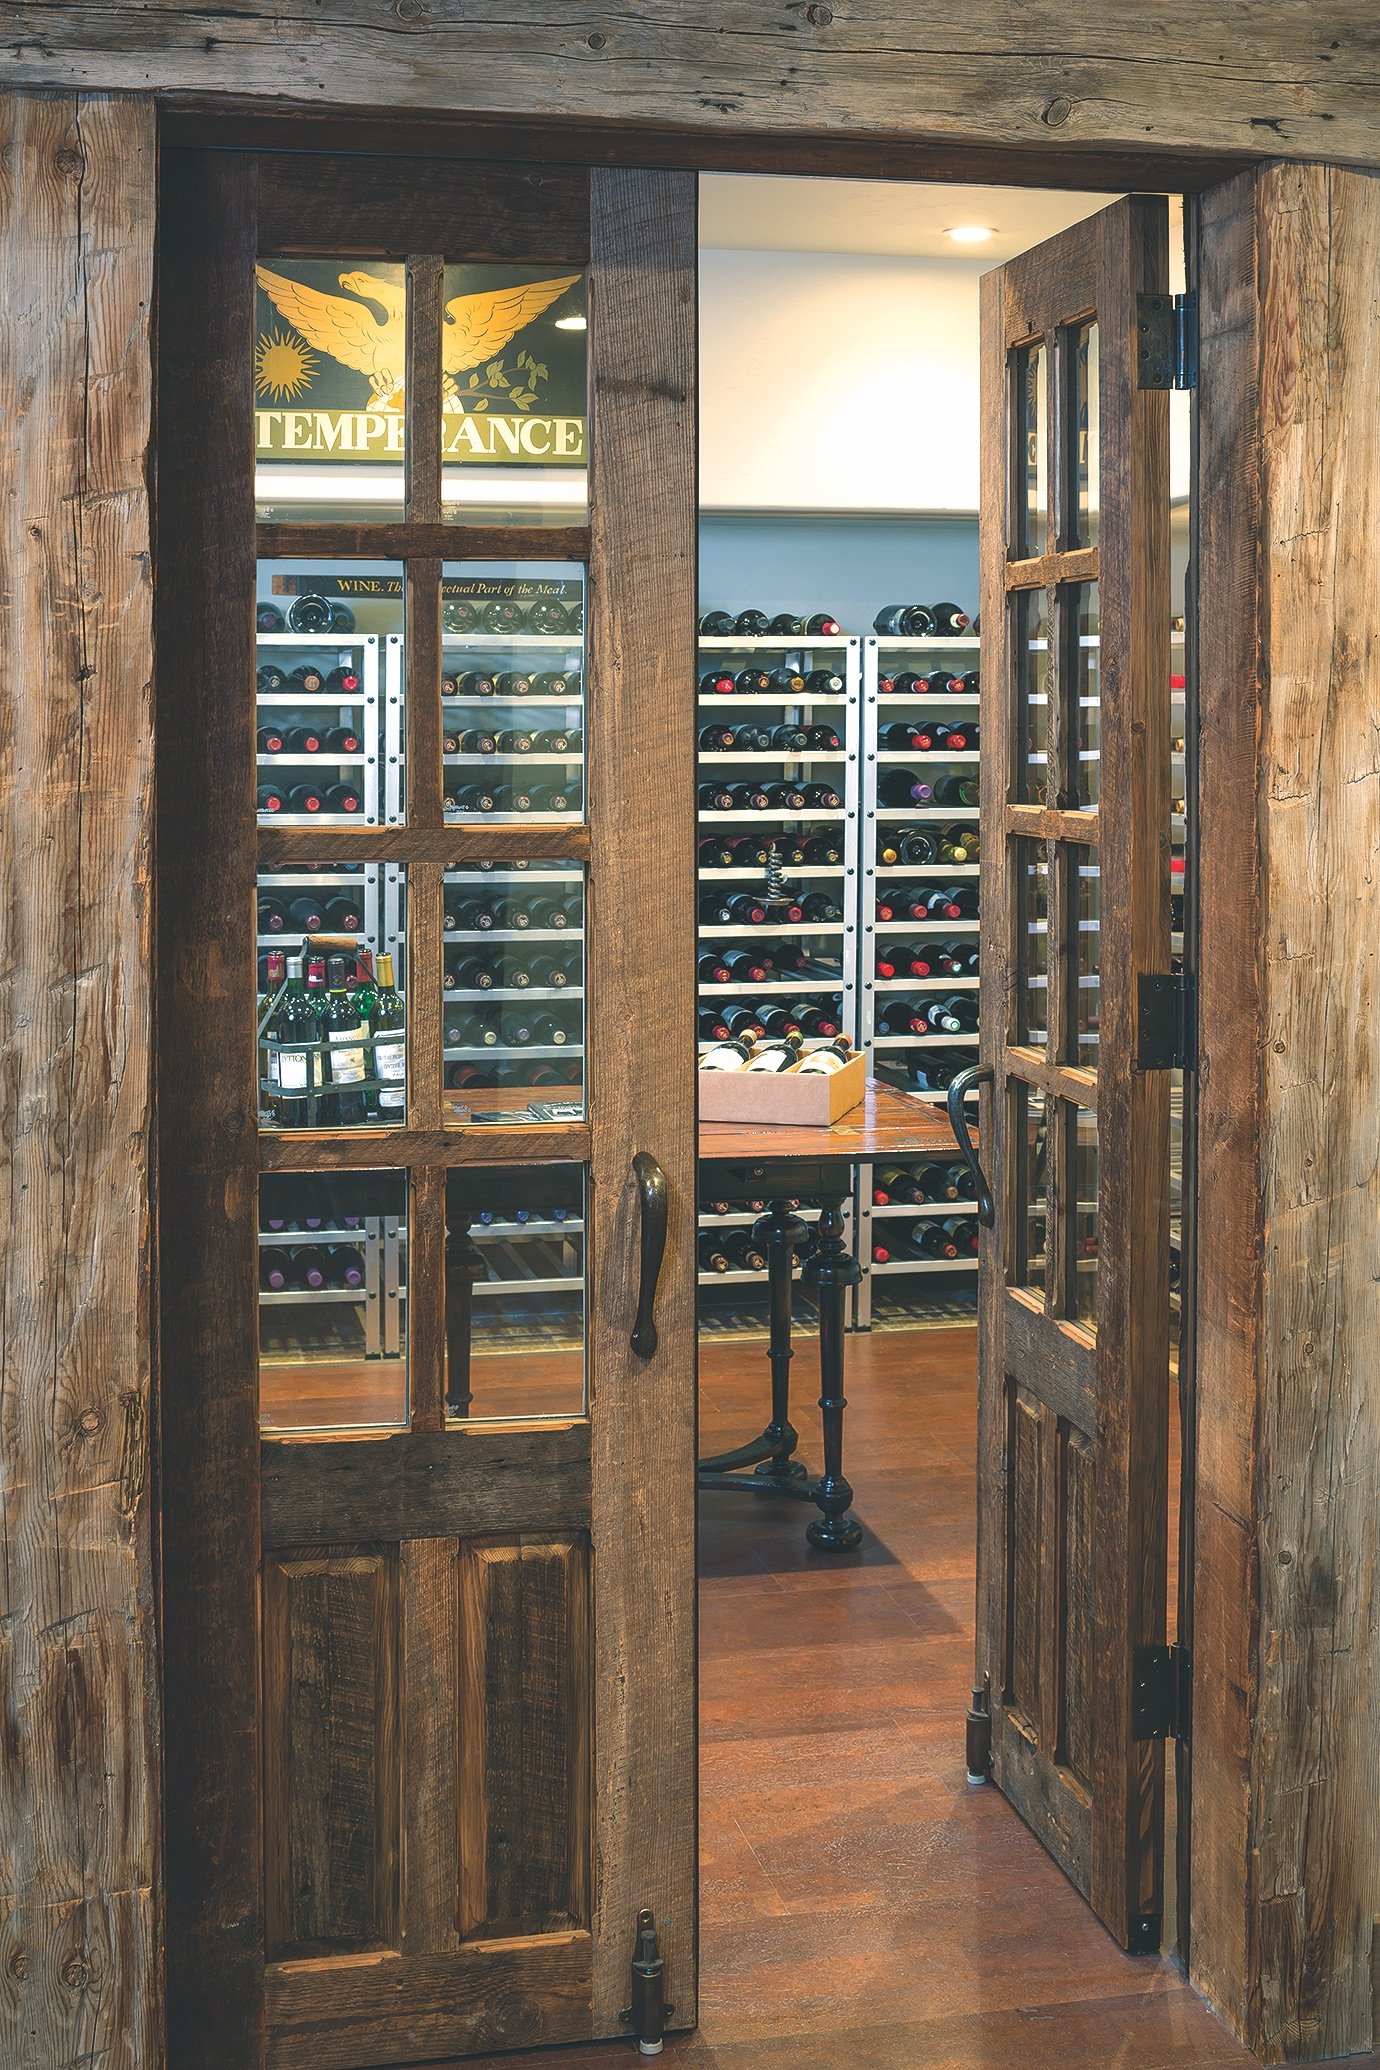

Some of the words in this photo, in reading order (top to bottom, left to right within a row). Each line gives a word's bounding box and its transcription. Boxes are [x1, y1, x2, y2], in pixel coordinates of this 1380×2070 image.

[255, 411, 583, 455] TEMPEANCE
[337, 579, 384, 592] WINE.
[441, 583, 475, 594] ectual
[476, 583, 502, 594] Part
[504, 584, 515, 596] of
[518, 583, 533, 594] the
[536, 584, 567, 595] Meal.
